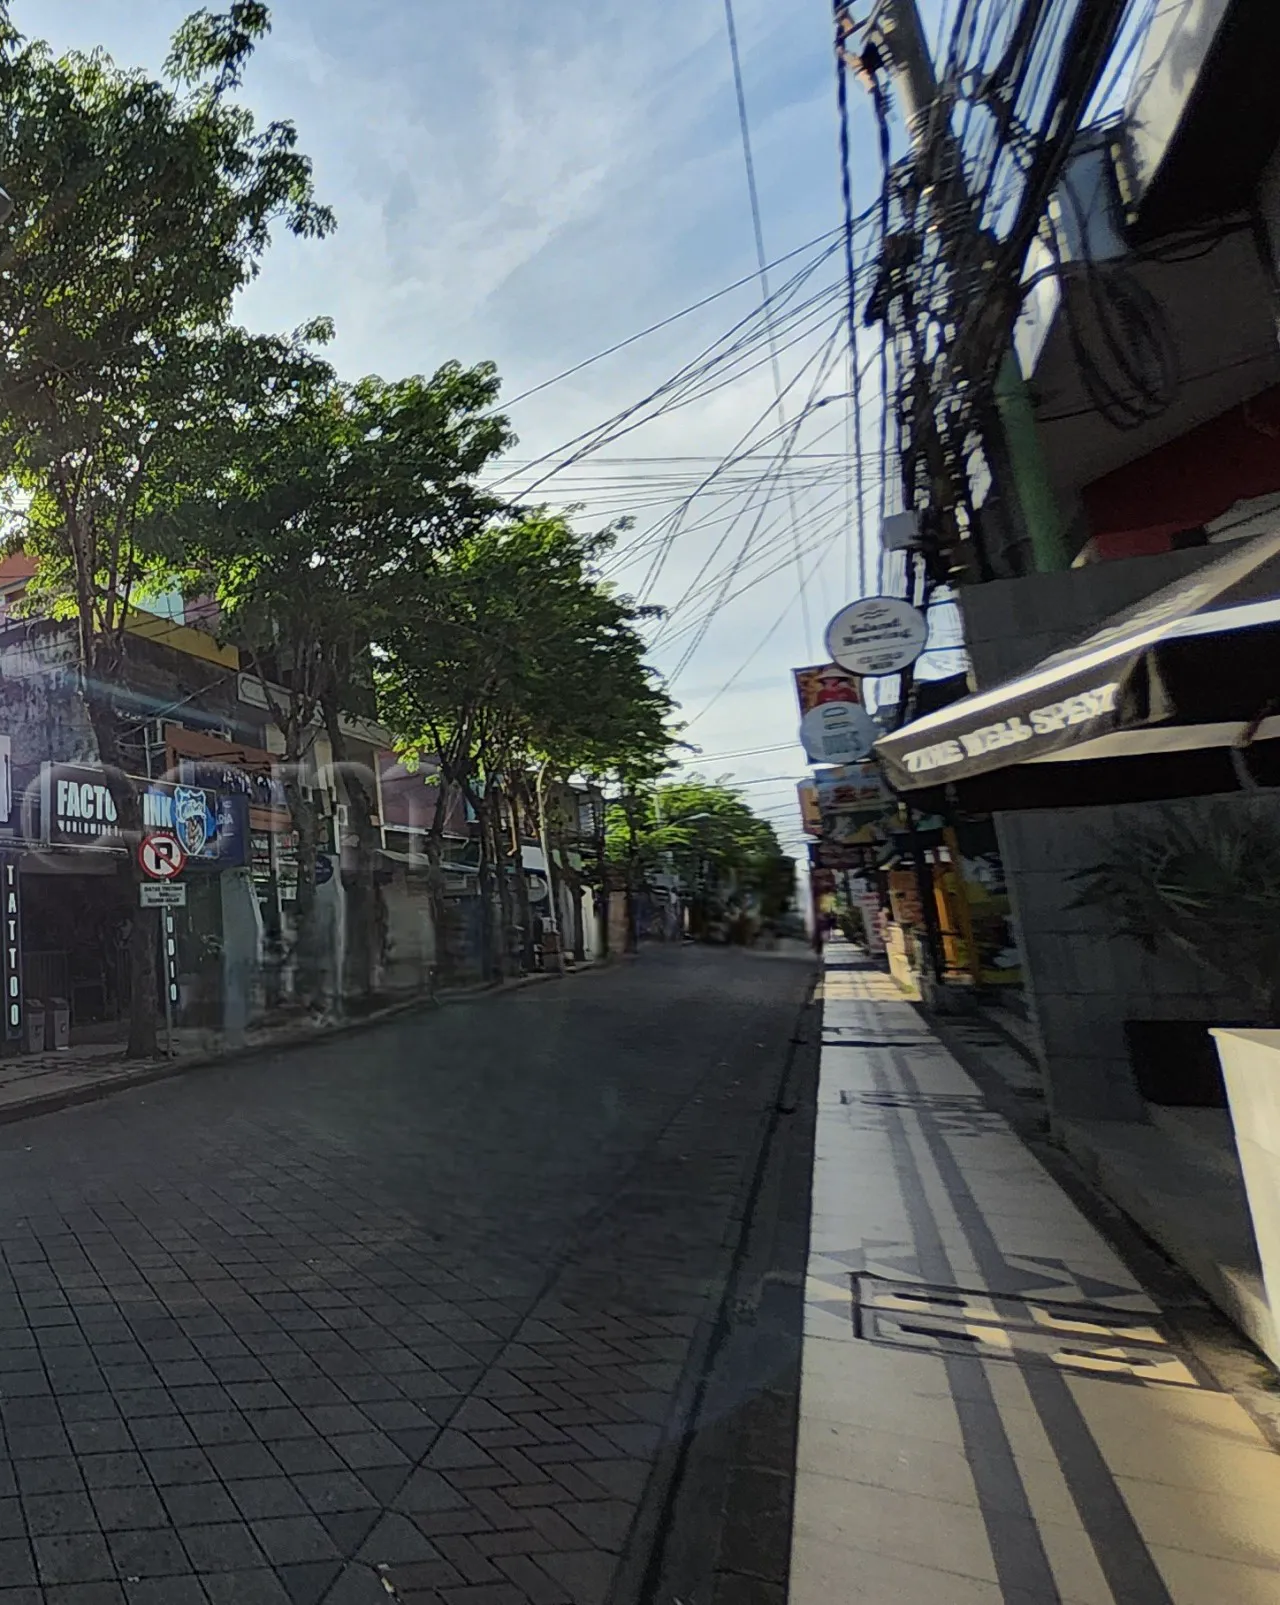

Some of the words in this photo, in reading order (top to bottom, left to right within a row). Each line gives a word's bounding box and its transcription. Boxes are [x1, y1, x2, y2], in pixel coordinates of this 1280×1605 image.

[57, 780, 118, 822] FACTO
[142, 793, 174, 828] INK
[6, 864, 19, 1026] TATTOO
[166, 915, 178, 1001] UDIO
